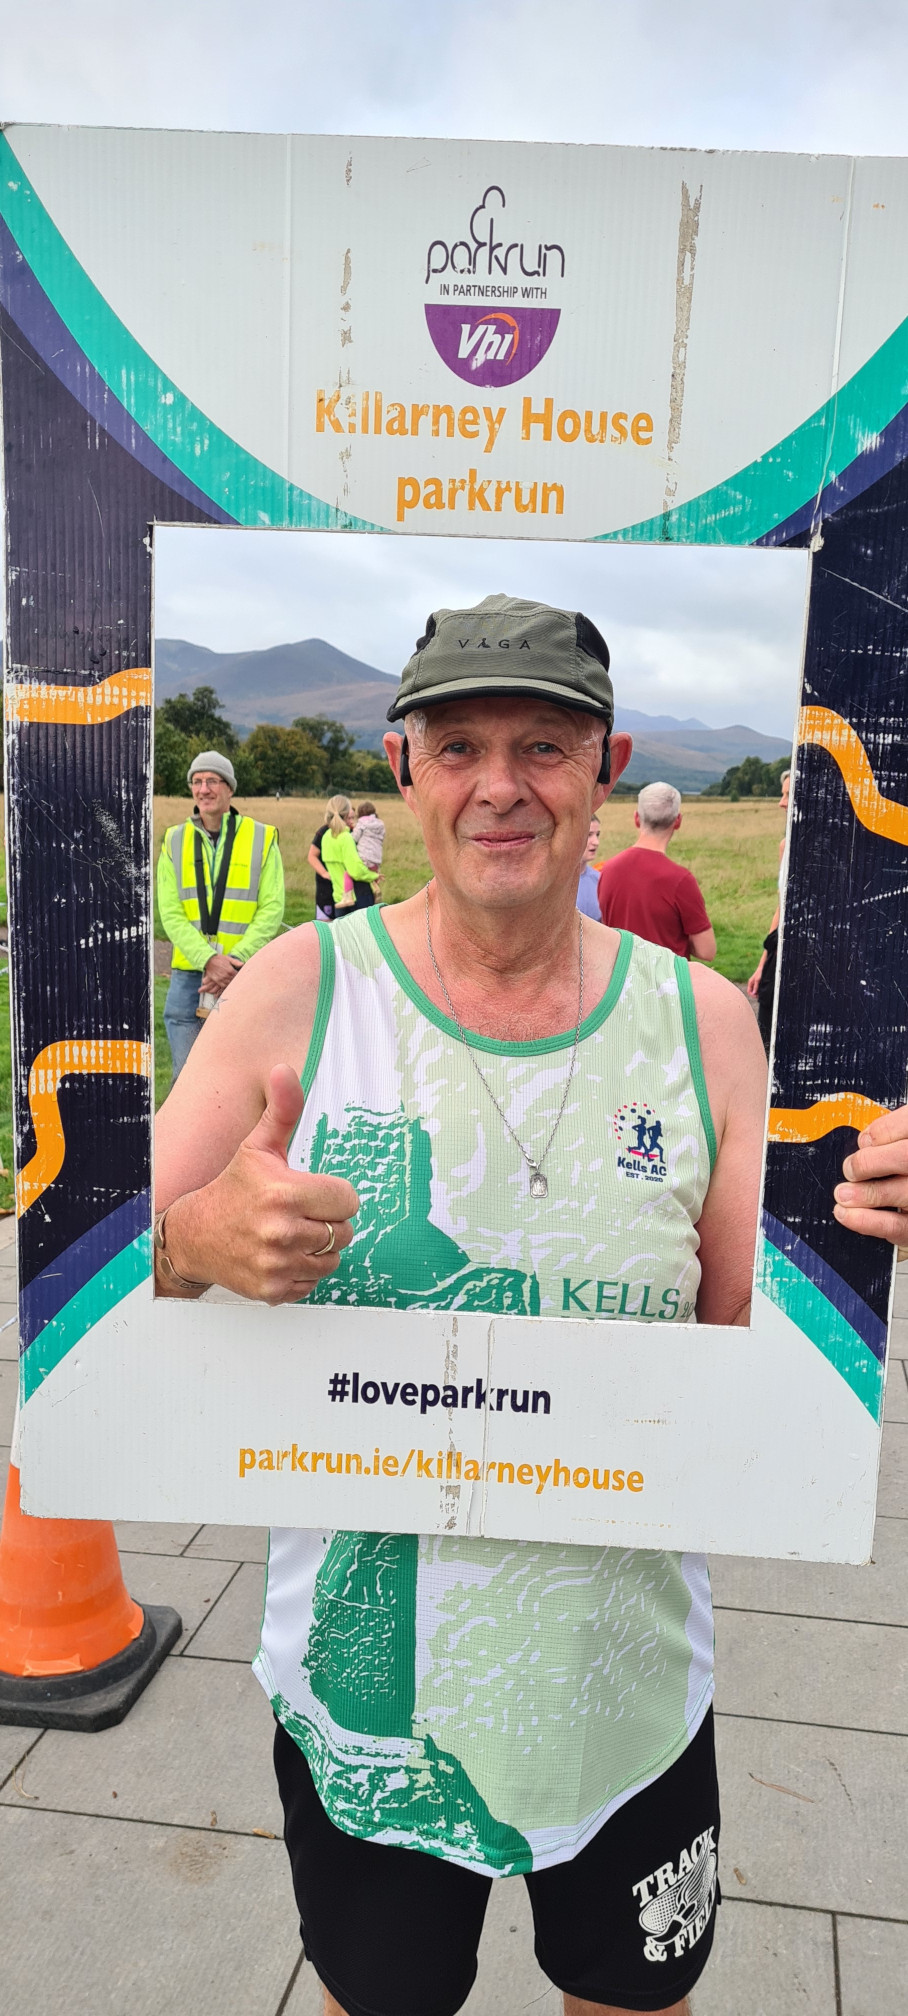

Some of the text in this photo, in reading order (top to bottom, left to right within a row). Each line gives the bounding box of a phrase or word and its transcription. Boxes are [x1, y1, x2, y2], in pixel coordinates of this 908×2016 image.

[425, 200, 565, 284] parkrun
[439, 283, 548, 300] IN PARTNERSHIP WITH
[457, 323, 514, 361] Vhi
[315, 389, 654, 453] Killarney House
[396, 468, 565, 522] parkrun
[617, 1156, 667, 1176] Kells AC
[644, 1175, 664, 1183] 2020
[562, 1278, 680, 1320] KELLS
[327, 1371, 551, 1415] #loveparkrun
[238, 1443, 645, 1495] parkrun.ie/killarneyhouse
[632, 1826, 717, 1907] TRACK
[643, 1936, 668, 1962] &
